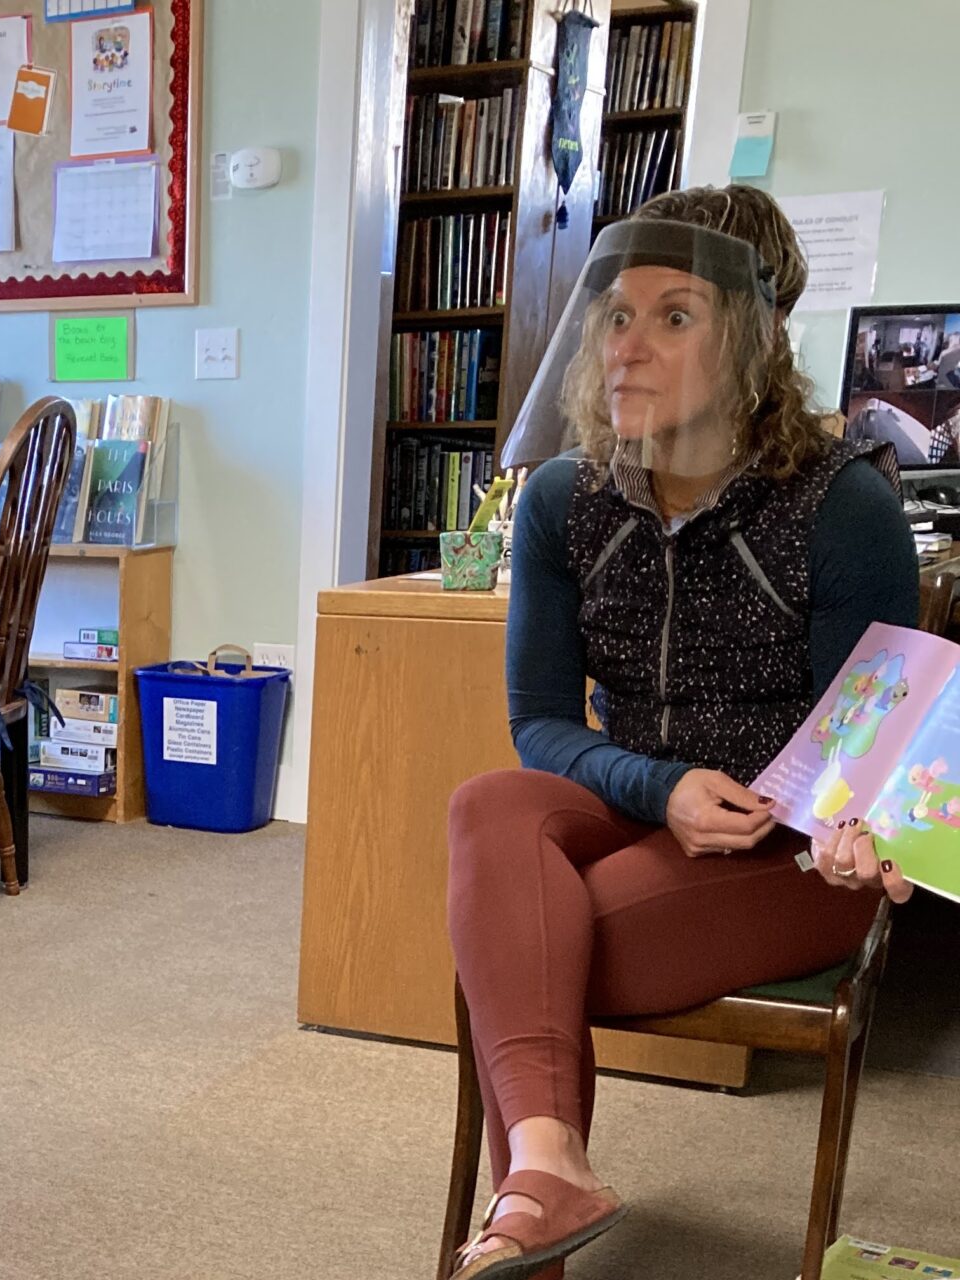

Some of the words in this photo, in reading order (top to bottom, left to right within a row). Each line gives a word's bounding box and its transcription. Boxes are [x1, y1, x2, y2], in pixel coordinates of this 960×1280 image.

[87, 78, 133, 93] Storytime
[814, 216, 824, 225] OF
[97, 480, 133, 495] PARIS
[87, 509, 132, 525] HOURS
[184, 741, 211, 749] Containers
